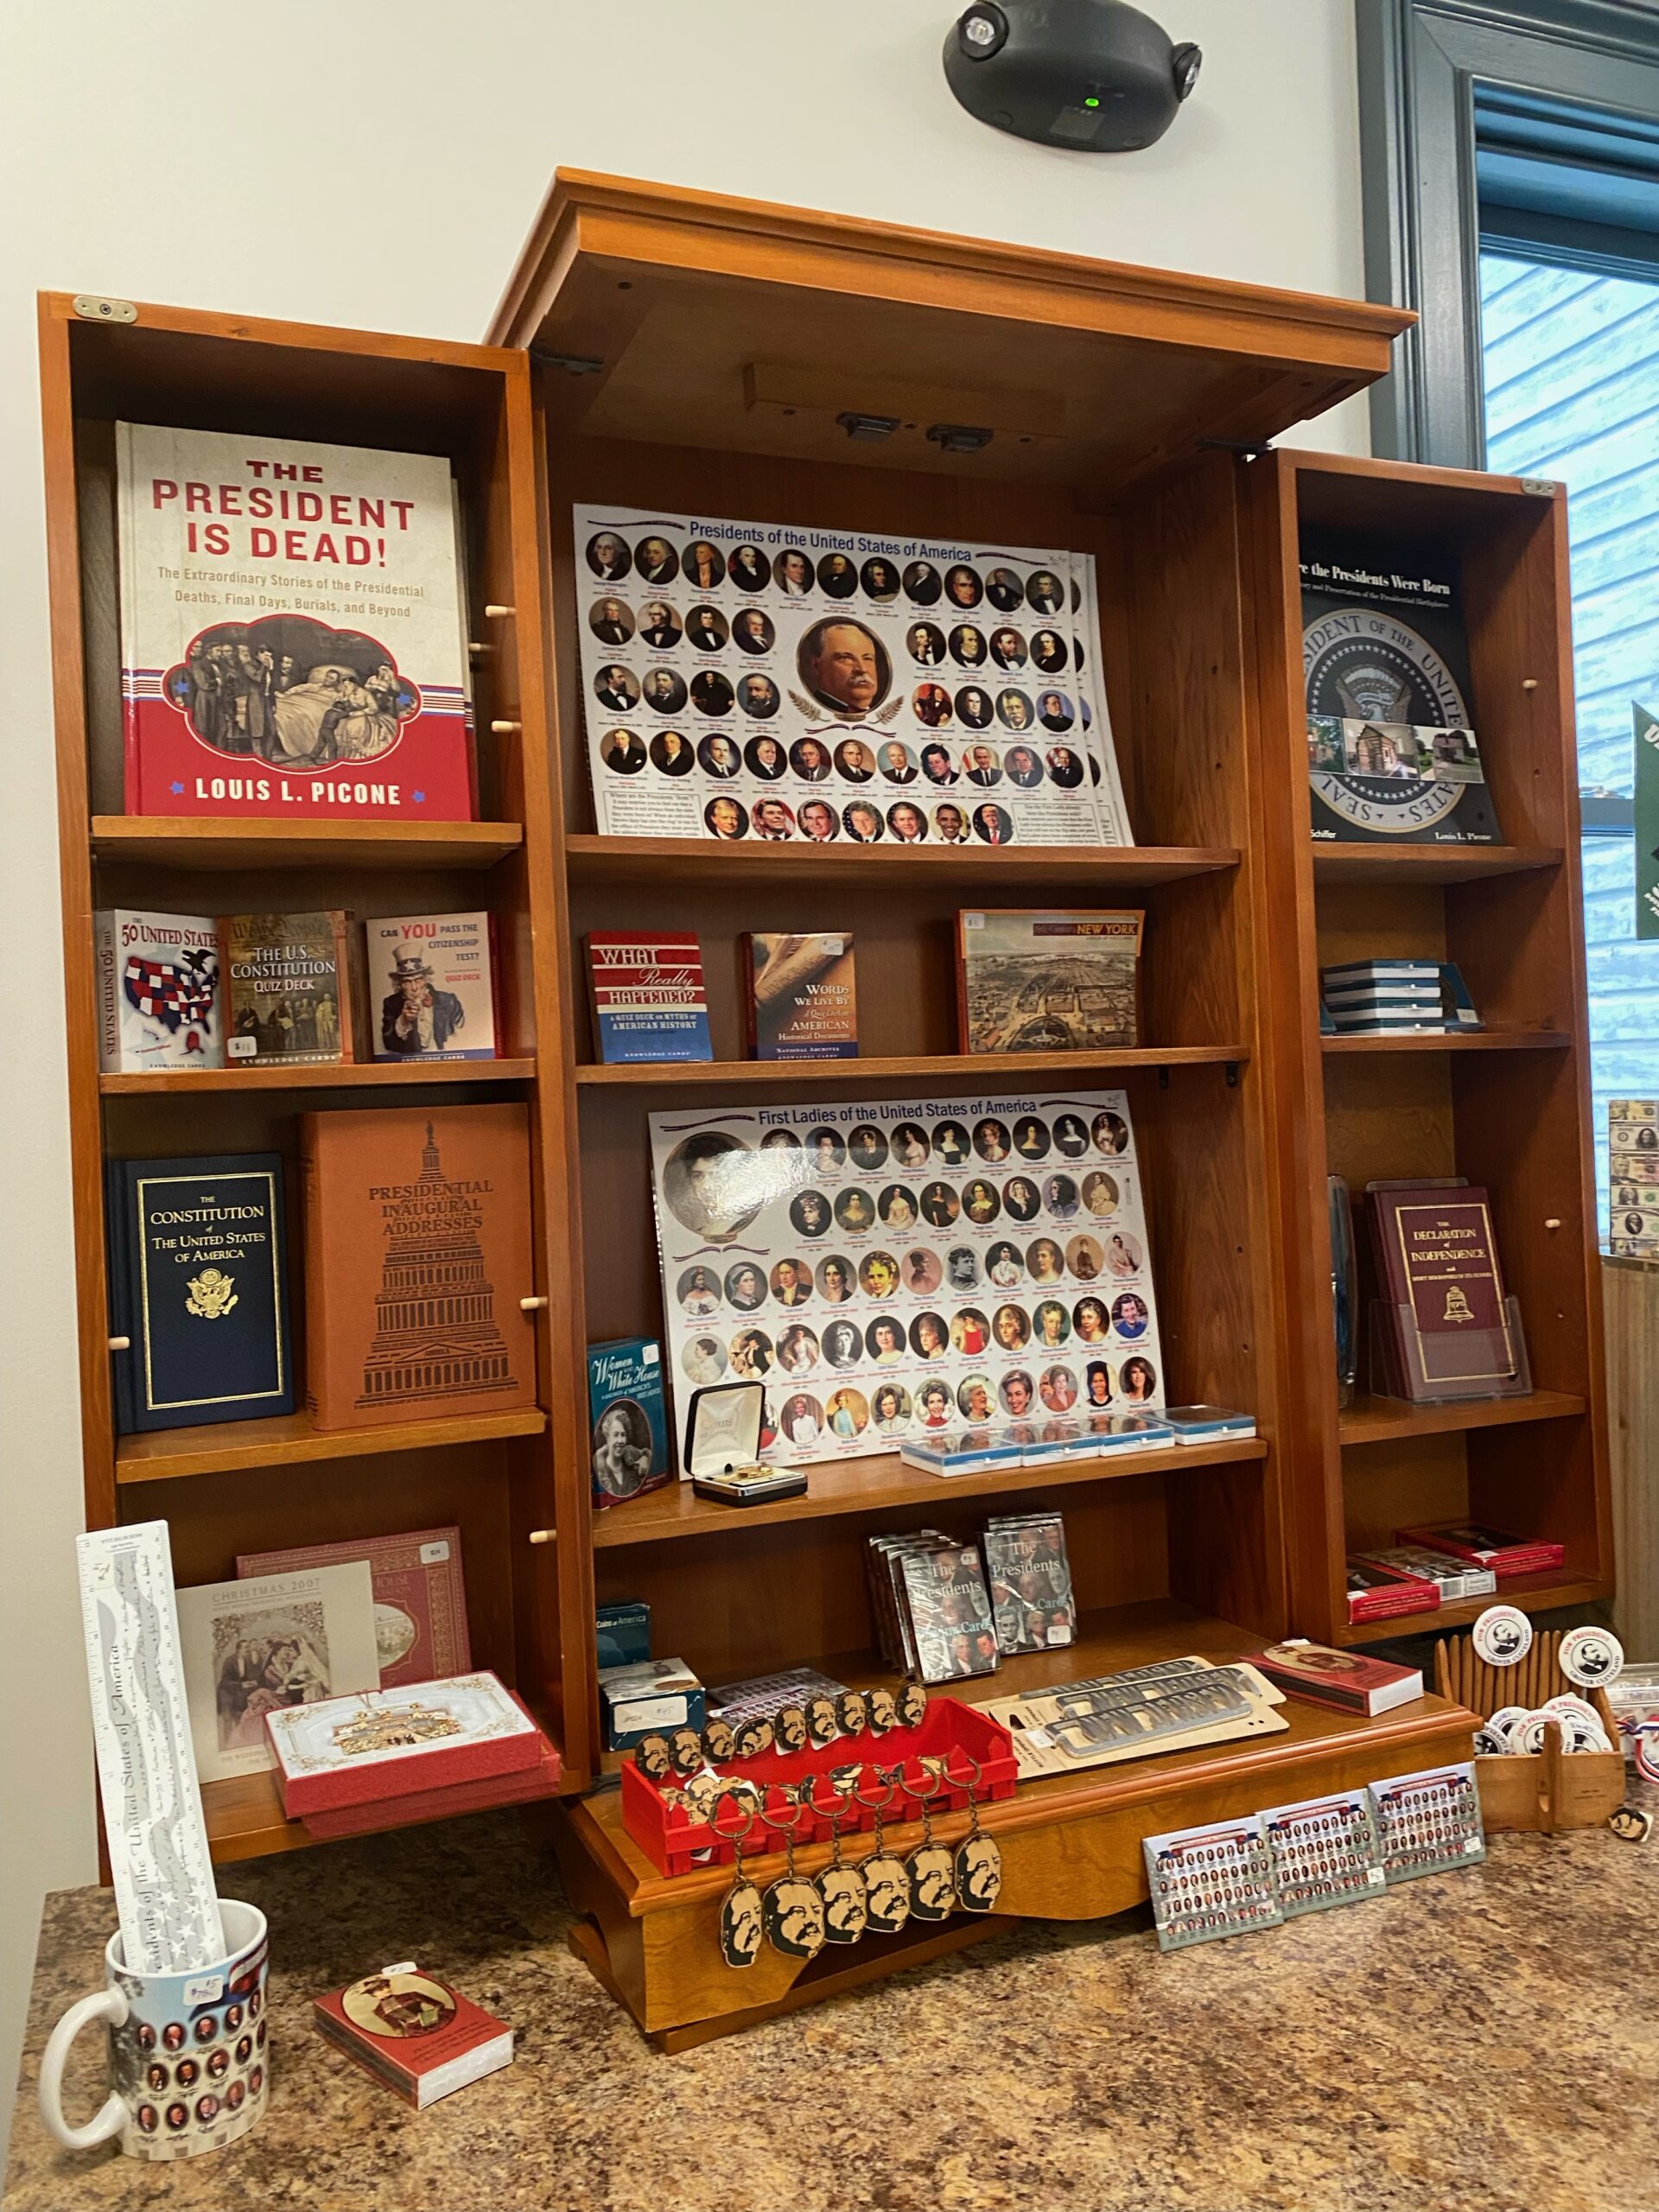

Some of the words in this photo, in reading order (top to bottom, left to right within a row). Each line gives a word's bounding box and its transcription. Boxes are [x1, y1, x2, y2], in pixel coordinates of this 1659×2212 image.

[246, 460, 324, 483] THE
[152, 479, 415, 531] PRESIDENT
[187, 523, 230, 556] IS
[251, 528, 386, 567] DEAD!
[690, 521, 764, 542] Presidents
[768, 529, 781, 543] of
[785, 531, 806, 545] the
[810, 534, 854, 550] United
[858, 537, 899, 555] States
[904, 543, 917, 556] of
[918, 546, 971, 562] America
[157, 566, 179, 580] The
[184, 568, 266, 587] Extraordinary
[270, 574, 313, 588] Stories
[316, 575, 329, 589] of
[332, 578, 351, 591] the
[355, 581, 424, 597] Presidential
[1312, 563, 1330, 577] the
[1332, 566, 1389, 587] Presidents
[1390, 575, 1420, 590] Were
[1423, 579, 1450, 594] Born
[175, 589, 220, 606] Deaths,
[226, 592, 255, 607] Final
[259, 596, 291, 611] Days,
[295, 598, 340, 613] Burials,
[344, 601, 365, 614] and
[369, 602, 410, 619] Beyond
[1370, 620, 1387, 635] OF
[1389, 628, 1415, 652] THE
[1421, 653, 1464, 728] UNITE
[196, 778, 270, 801] LOUIS
[282, 780, 302, 802] L.
[311, 781, 401, 805] PICONE
[122, 925, 137, 946] 50
[141, 925, 181, 944] UNITED
[401, 923, 437, 939] YOU
[440, 925, 461, 933] PASS
[1077, 925, 1103, 934] NEW
[1106, 925, 1135, 934] YORK
[253, 947, 281, 961] THE
[286, 944, 309, 959] U.S.
[429, 938, 479, 949] CITIZENSHIP
[100, 950, 114, 966] 50
[456, 952, 480, 961] TEST?
[599, 948, 658, 965] WHAT
[231, 960, 335, 978] CONSTITUTION
[632, 965, 694, 991] Really
[103, 969, 115, 1012] UNITED
[254, 980, 281, 993] QUIZ
[285, 978, 315, 991] DECK
[805, 985, 849, 995] WORDS
[609, 990, 696, 1004] HAPPENED?
[794, 997, 811, 1006] WE
[105, 1014, 117, 1056] STATES
[791, 1021, 849, 1030] AMERICAN
[759, 1110, 790, 1125] First
[793, 1109, 836, 1122] Ladies
[840, 1107, 853, 1121] of
[856, 1106, 877, 1120] the
[880, 1105, 923, 1119] United
[926, 1103, 966, 1117] States
[970, 1102, 983, 1114] of
[986, 1100, 1036, 1114] America
[200, 1195, 216, 1204] THE
[369, 1180, 493, 1201] PRESIDENTIAL
[150, 1205, 264, 1225] CONSTITUTION
[382, 1198, 483, 1218] INAUGURAL
[383, 1216, 483, 1236] ADDRESSES
[1414, 1229, 1476, 1240] DECLARATION
[152, 1236, 177, 1249] THE
[179, 1235, 224, 1248] UNITED
[226, 1232, 266, 1244] STATES
[193, 1249, 245, 1262] AMERICA
[1411, 1249, 1486, 1262] INDEPENDENCE
[592, 1357, 632, 1384] Women
[608, 1373, 632, 1391] White
[634, 1365, 660, 1383] House
[1012, 1542, 1036, 1554] The
[931, 1563, 956, 1578] The
[992, 1559, 1061, 1578] Presidents
[212, 1583, 284, 1602] CHRISTMAS
[291, 1578, 321, 1591] 2007
[912, 1580, 982, 1599] esidents
[619, 1616, 645, 1624] America
[1563, 1642, 1573, 1654] FOR
[109, 1643, 127, 1716] America
[1570, 1671, 1593, 1684] GROVER
[1597, 1656, 1620, 1684] CLEVELAND
[1559, 1701, 1597, 1720] PRESIDENT
[113, 1723, 130, 1735] of
[1517, 1723, 1526, 1736] FOR
[119, 1740, 135, 1789] States
[123, 1794, 143, 1857] United
[135, 1859, 149, 1884] the
[137, 1890, 154, 1904] of
[143, 1909, 163, 1971] esidents
